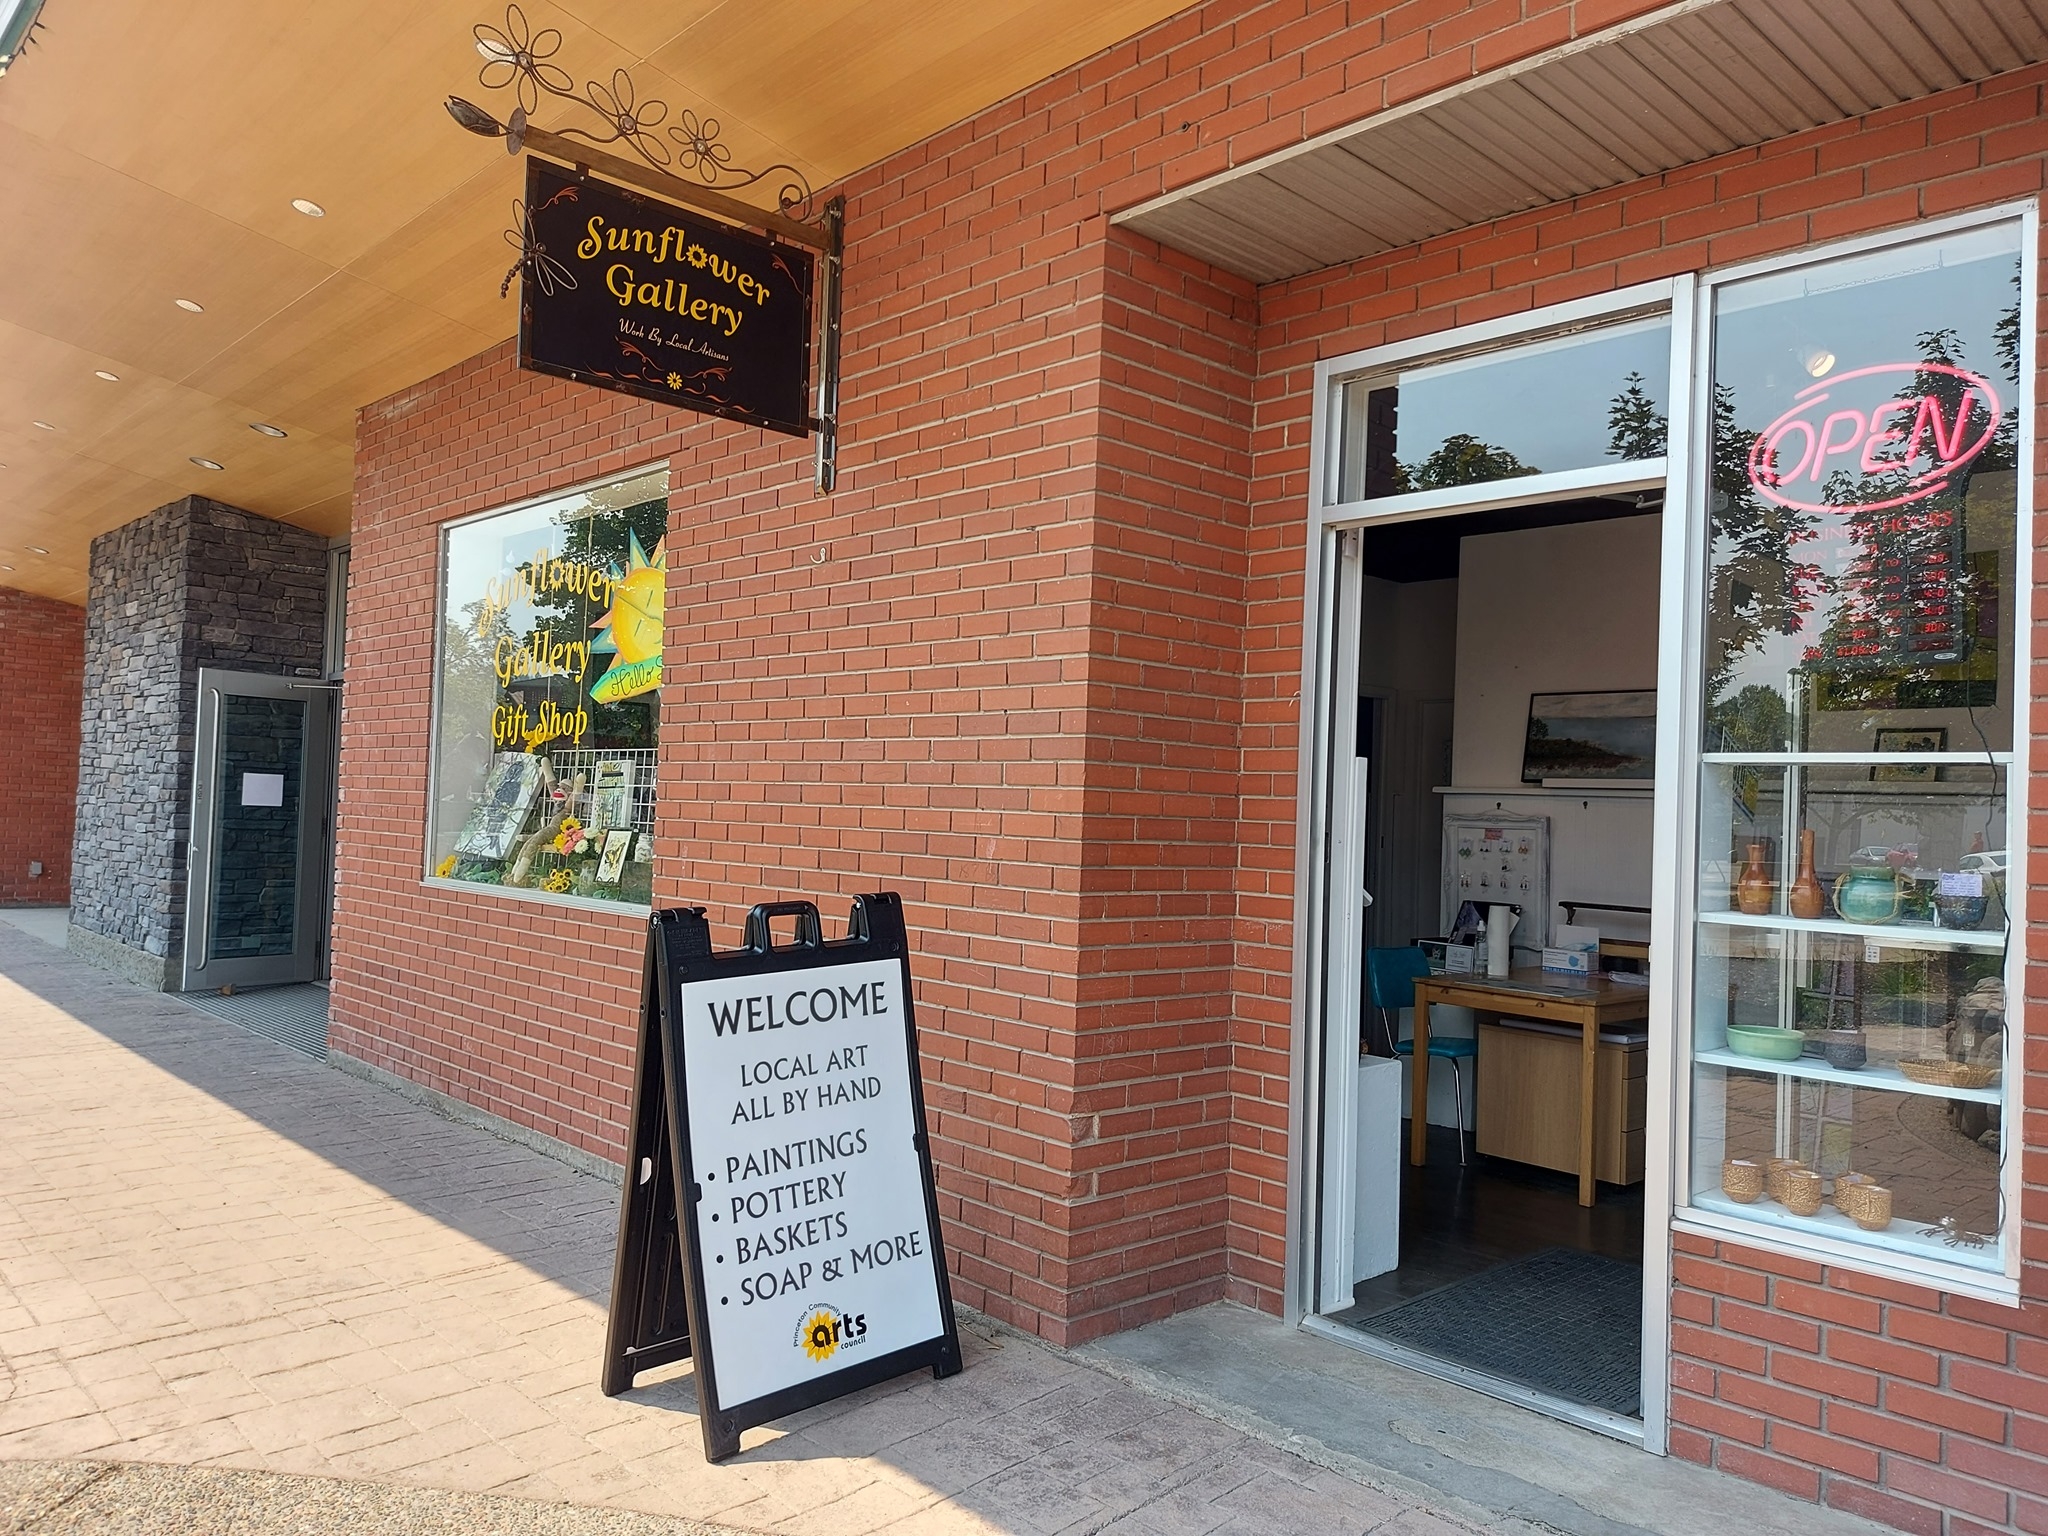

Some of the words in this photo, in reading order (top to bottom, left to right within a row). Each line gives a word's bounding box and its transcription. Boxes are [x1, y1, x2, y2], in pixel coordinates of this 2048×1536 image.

[577, 215, 771, 306] Sunflower
[605, 263, 743, 337] Gallery
[619, 317, 645, 339] Work
[648, 327, 662, 346] By
[665, 333, 694, 351] Local
[691, 341, 729, 361] Artisans
[1761, 389, 1974, 487] OPEN
[478, 547, 616, 638] Sunflower
[494, 630, 592, 688] Gallery
[491, 703, 530, 746] Gift
[533, 699, 588, 745] Shop
[707, 981, 889, 1037] WELCOME
[740, 1053, 819, 1087] LOCAL
[825, 1044, 869, 1072] ART
[730, 1096, 776, 1126] ALL
[783, 1089, 809, 1115] BY
[817, 1076, 882, 1108] HAND
[725, 1128, 869, 1184] PAINTINGS
[731, 1170, 848, 1224] POTTERY
[735, 1211, 848, 1265] BASKETS
[741, 1262, 813, 1306] SOAP
[821, 1257, 845, 1282] &
[850, 1230, 924, 1274] MORE
[793, 1310, 808, 1348] Princeton
[808, 1302, 842, 1317] Community
[812, 1312, 868, 1348] arts
[840, 1334, 867, 1350] council
